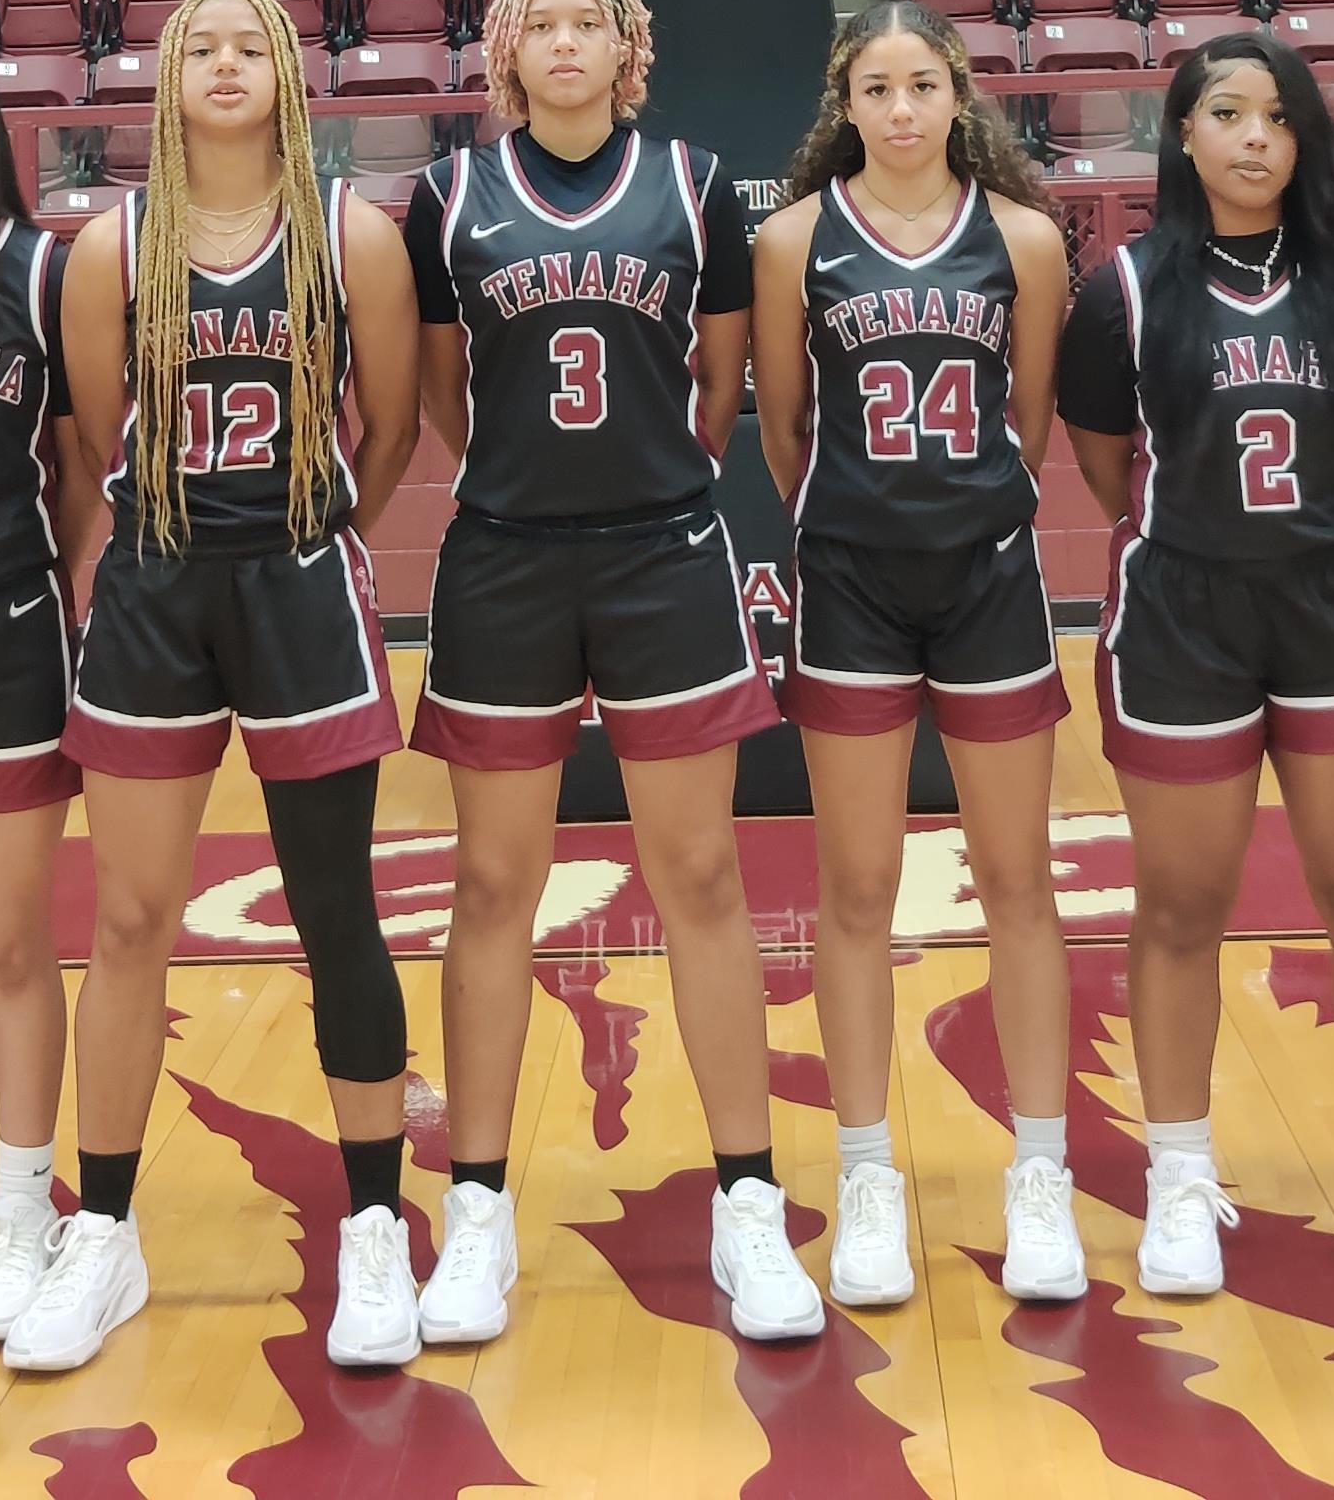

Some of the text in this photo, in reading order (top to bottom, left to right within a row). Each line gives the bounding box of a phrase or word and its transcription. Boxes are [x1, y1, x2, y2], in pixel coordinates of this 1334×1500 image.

[481, 251, 671, 321] TENAHA
[825, 287, 1006, 353] TENAHA
[176, 381, 281, 476] 12
[547, 327, 609, 431] 3
[859, 358, 980, 461] 24
[1235, 409, 1302, 513] 2
